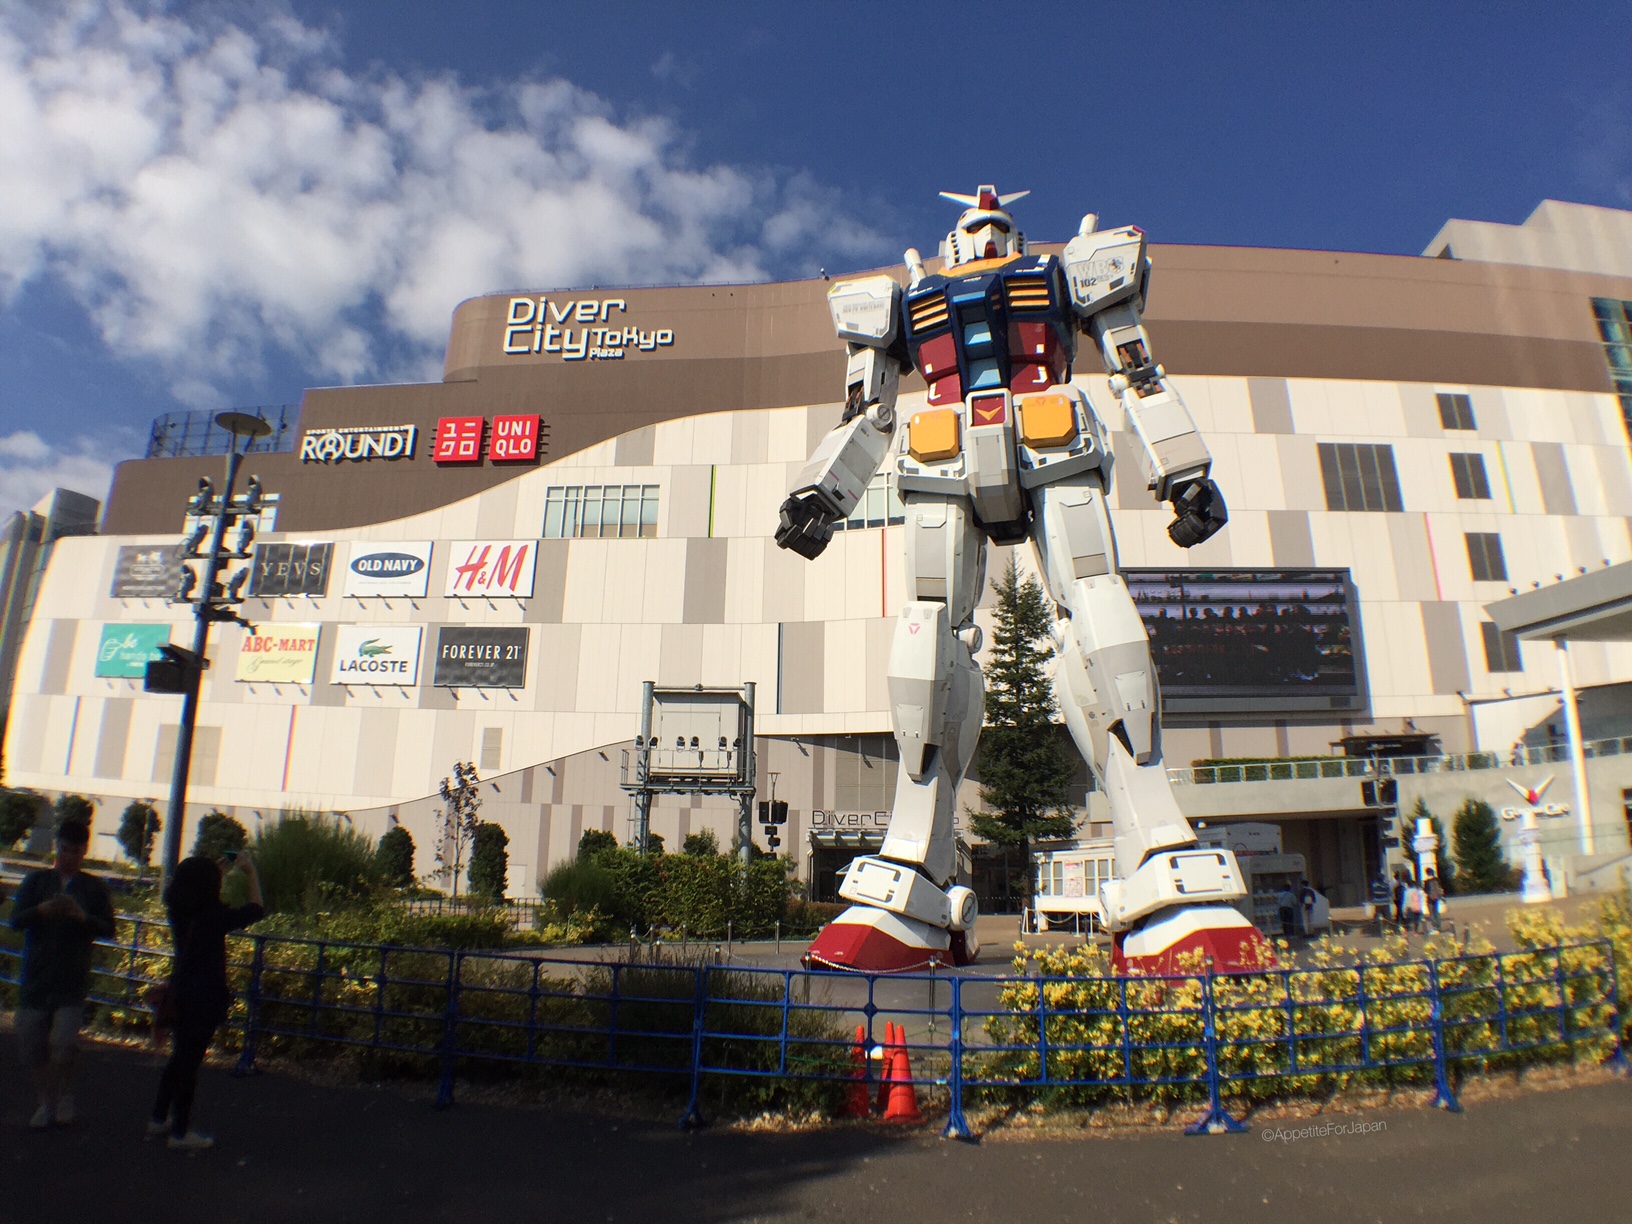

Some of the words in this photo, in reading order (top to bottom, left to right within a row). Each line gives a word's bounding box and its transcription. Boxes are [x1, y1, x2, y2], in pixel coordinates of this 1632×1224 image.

[1079, 277, 1098, 288] 102
[507, 296, 626, 324] Diver
[503, 324, 590, 359] City
[589, 347, 624, 359] Plaza
[443, 421, 476, 438] ユニ
[497, 420, 532, 437] UNI
[440, 440, 475, 456] クロ
[495, 438, 532, 457] QLO
[260, 562, 322, 577] YEVS
[357, 559, 382, 572] OLD
[383, 559, 418, 572] NAVY
[455, 545, 529, 592] H&M
[241, 635, 316, 653] ABC-MART
[442, 644, 502, 660] FOREVER
[505, 645, 519, 660] 21
[339, 659, 409, 673] LACOSTE
[812, 810, 893, 826] DiverC
